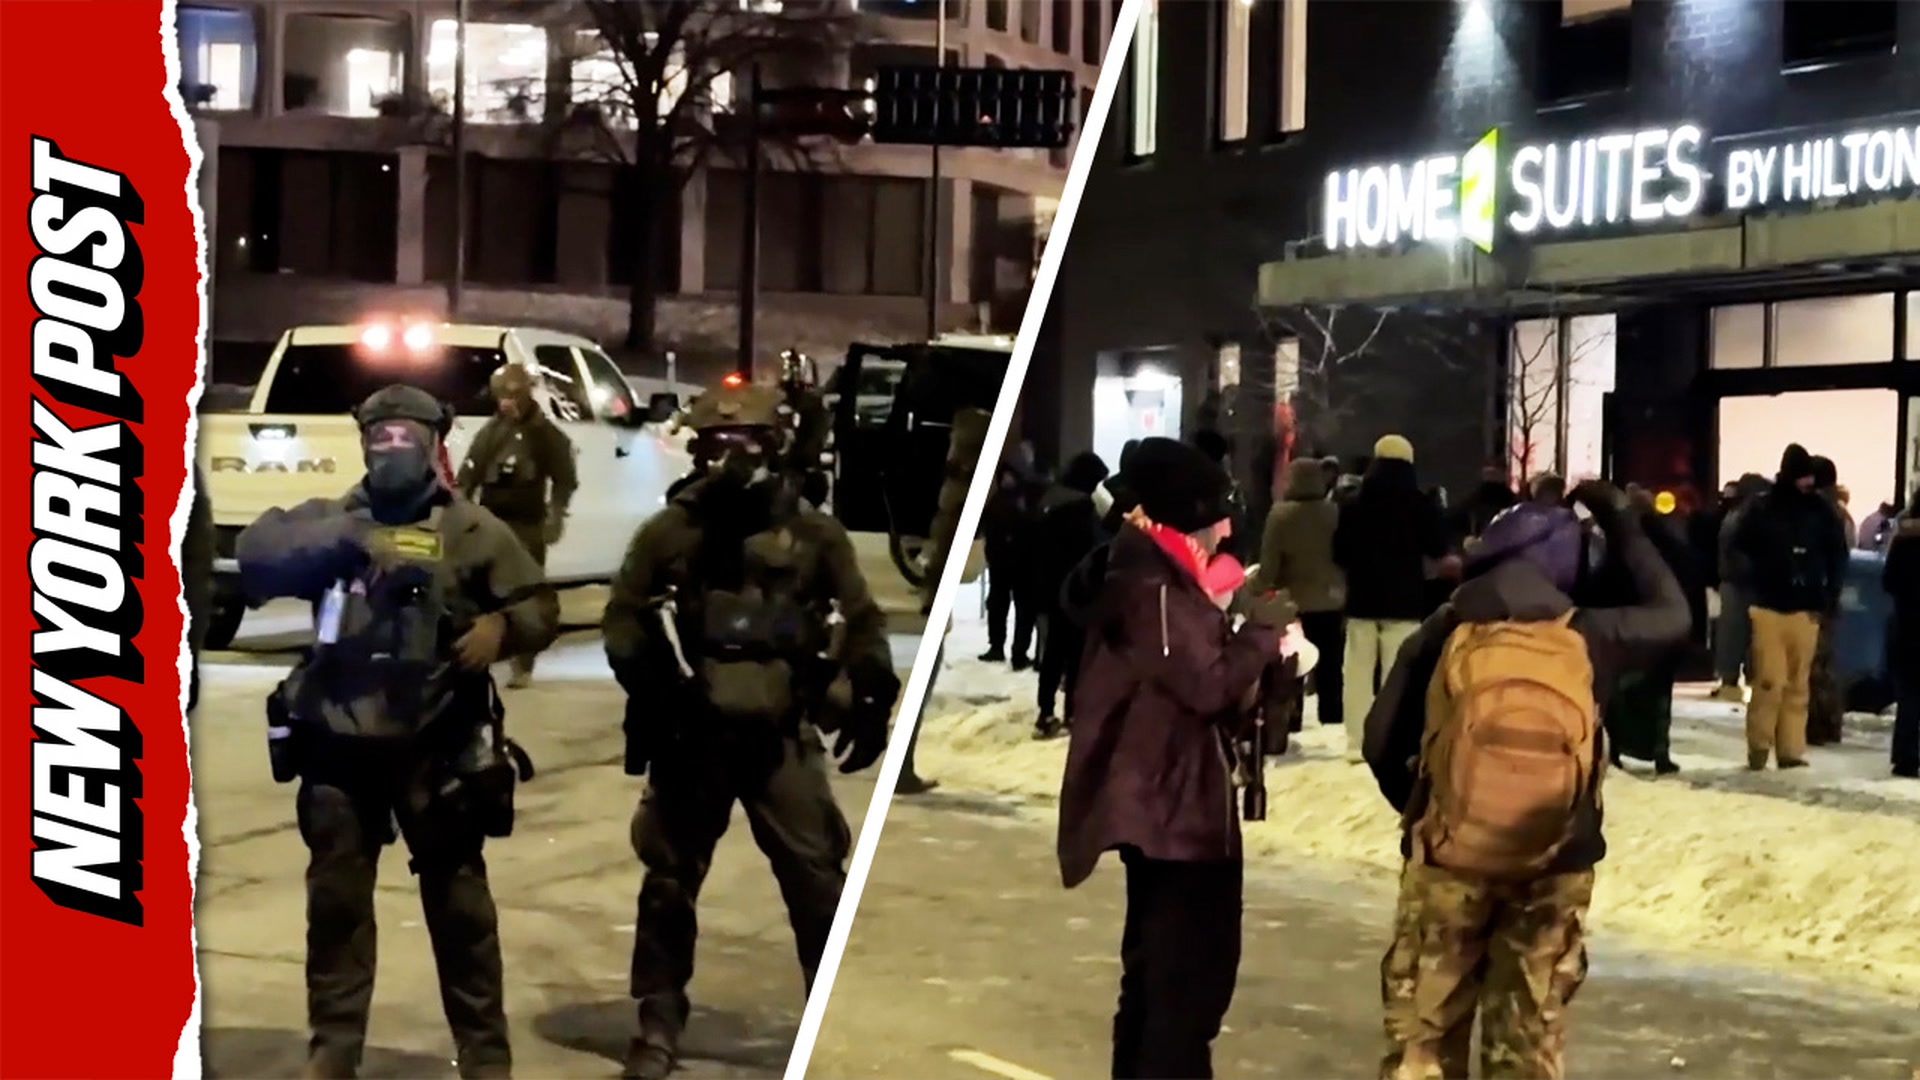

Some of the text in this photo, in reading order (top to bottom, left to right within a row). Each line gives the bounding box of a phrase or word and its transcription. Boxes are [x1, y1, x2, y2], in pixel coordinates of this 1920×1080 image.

[1508, 125, 1704, 232] SUITES
[1728, 147, 1776, 208] BY
[1783, 126, 1920, 202] HILTON
[211, 456, 337, 474] RAM
